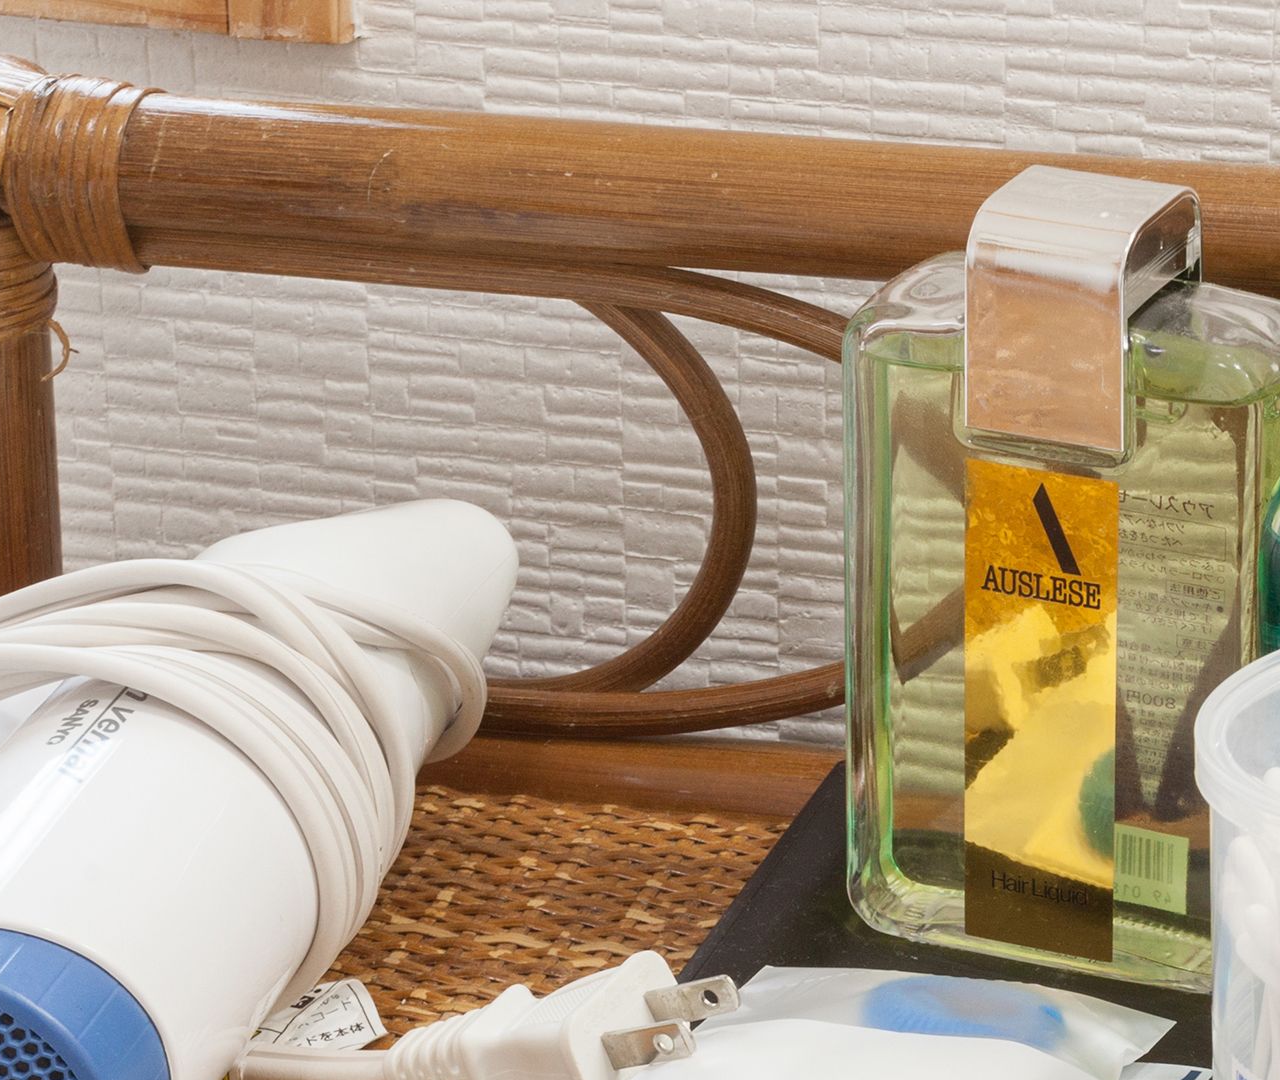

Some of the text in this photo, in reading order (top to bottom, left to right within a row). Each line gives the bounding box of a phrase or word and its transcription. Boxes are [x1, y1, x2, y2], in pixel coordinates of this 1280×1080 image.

[981, 563, 1101, 610] AUSLESE
[46, 699, 100, 745] SANYO
[991, 870, 1088, 906] Hair Liquid
